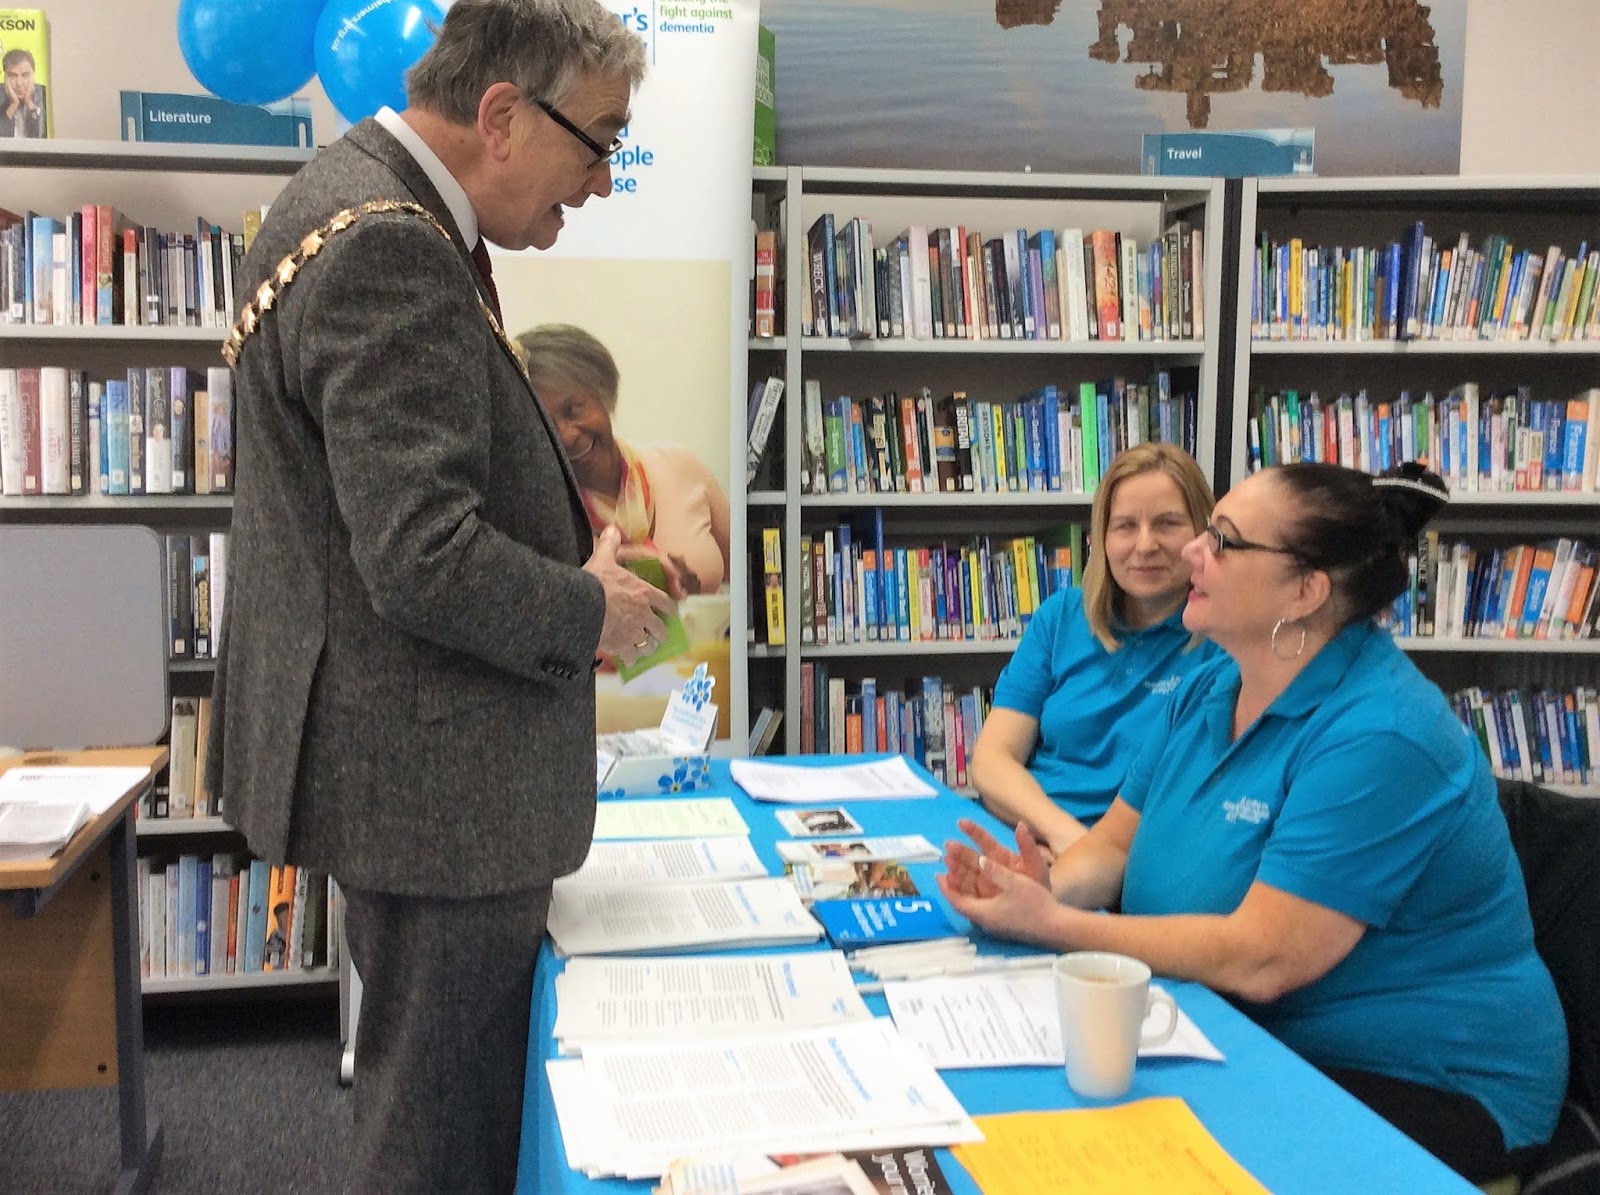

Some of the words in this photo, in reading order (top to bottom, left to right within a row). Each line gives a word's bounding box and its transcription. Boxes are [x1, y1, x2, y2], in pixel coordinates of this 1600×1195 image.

[659, 6, 688, 19] fight
[690, 7, 733, 20] against
[659, 21, 715, 33] dementia
[149, 109, 212, 125] Literature
[608, 145, 654, 171] ople
[1166, 146, 1203, 161] Travel
[610, 177, 637, 192] se
[812, 251, 825, 294] WRECK
[0, 394, 10, 449] DICKENS
[955, 405, 970, 450] BRITAIN
[1549, 418, 1561, 454] France
[831, 431, 840, 466] Europe
[1303, 418, 1312, 461] Germany
[1567, 423, 1583, 469] France
[894, 900, 932, 914] 5
